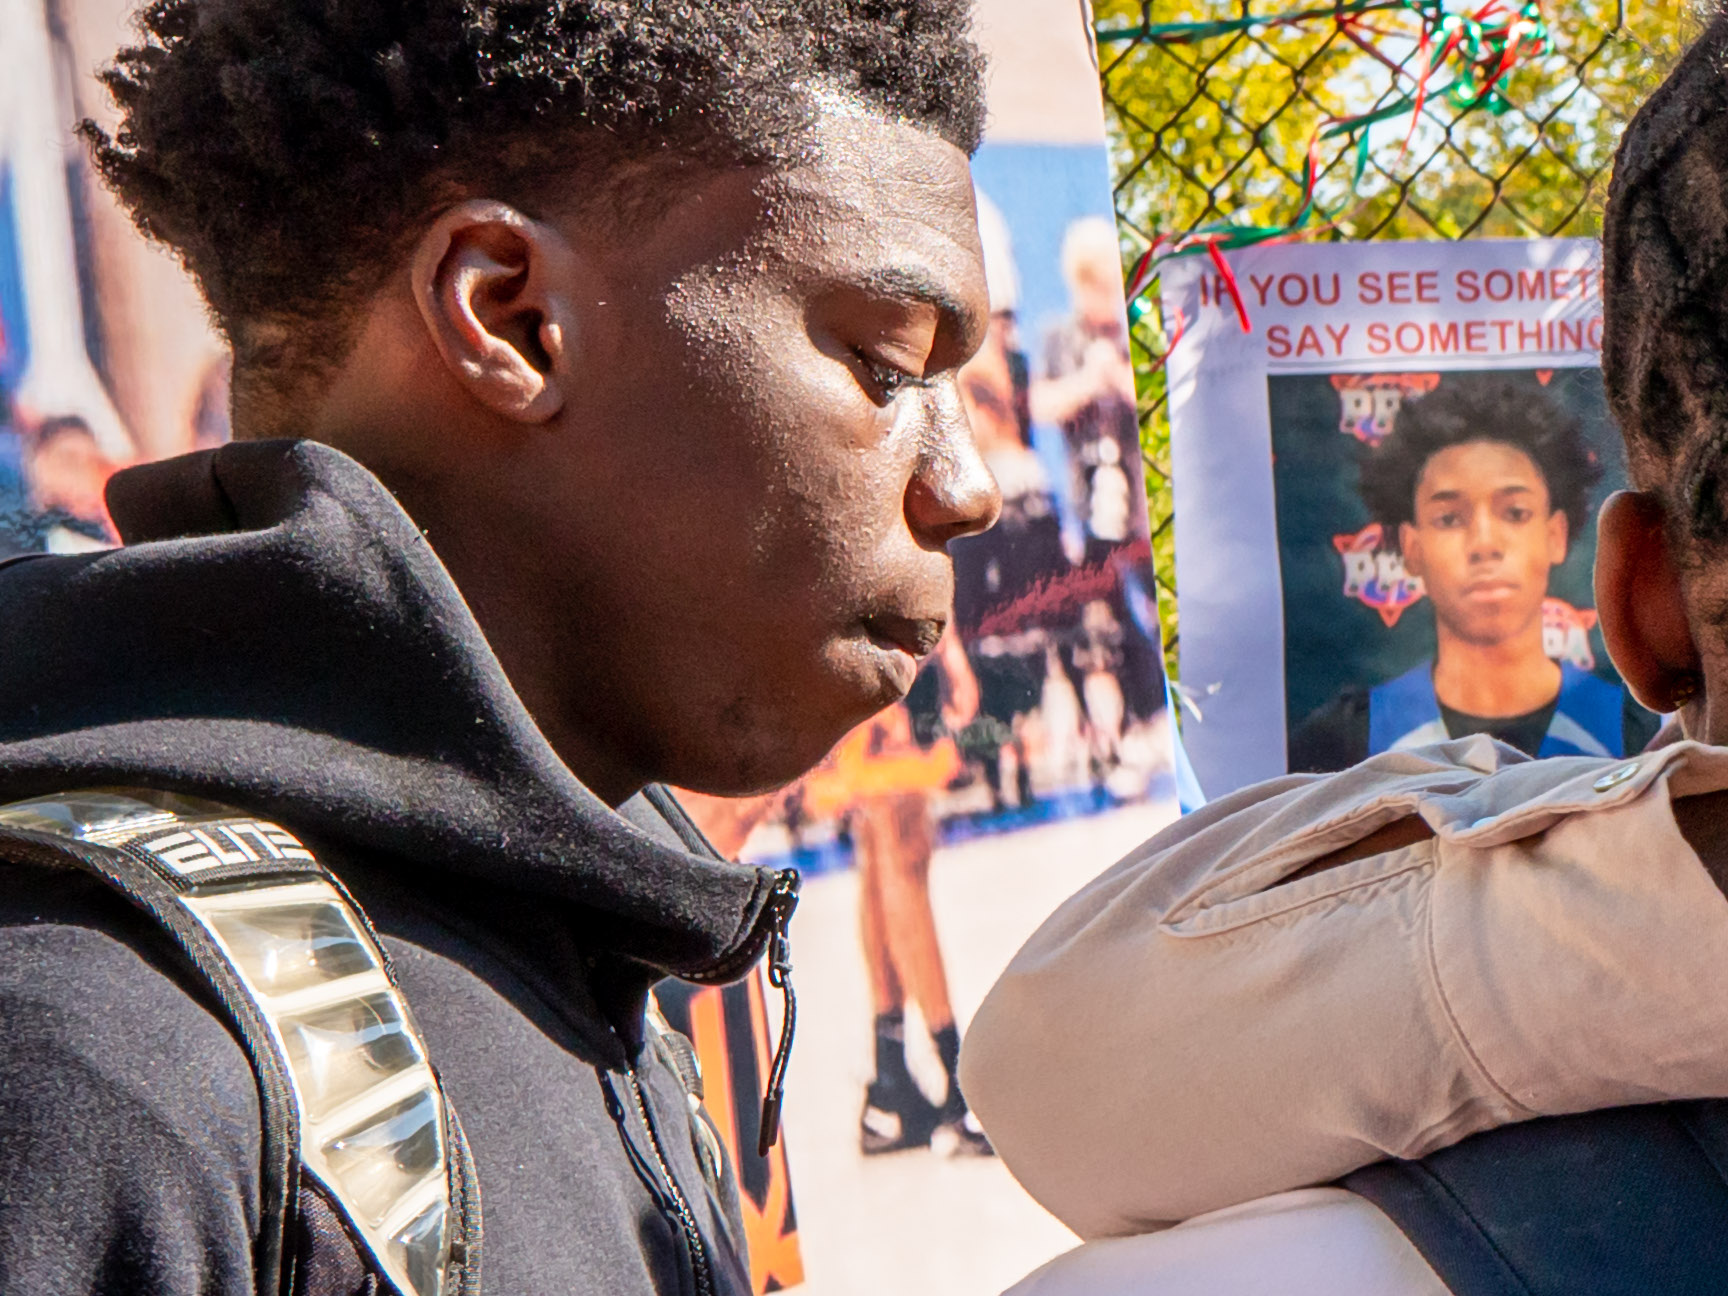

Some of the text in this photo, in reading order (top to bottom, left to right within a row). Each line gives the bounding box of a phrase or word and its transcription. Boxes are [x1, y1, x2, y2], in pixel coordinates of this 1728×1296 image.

[1250, 273, 1341, 307] YOU
[1357, 269, 1440, 305] SEE
[1455, 267, 1604, 304] SOMET
[1266, 323, 1351, 358] SAY
